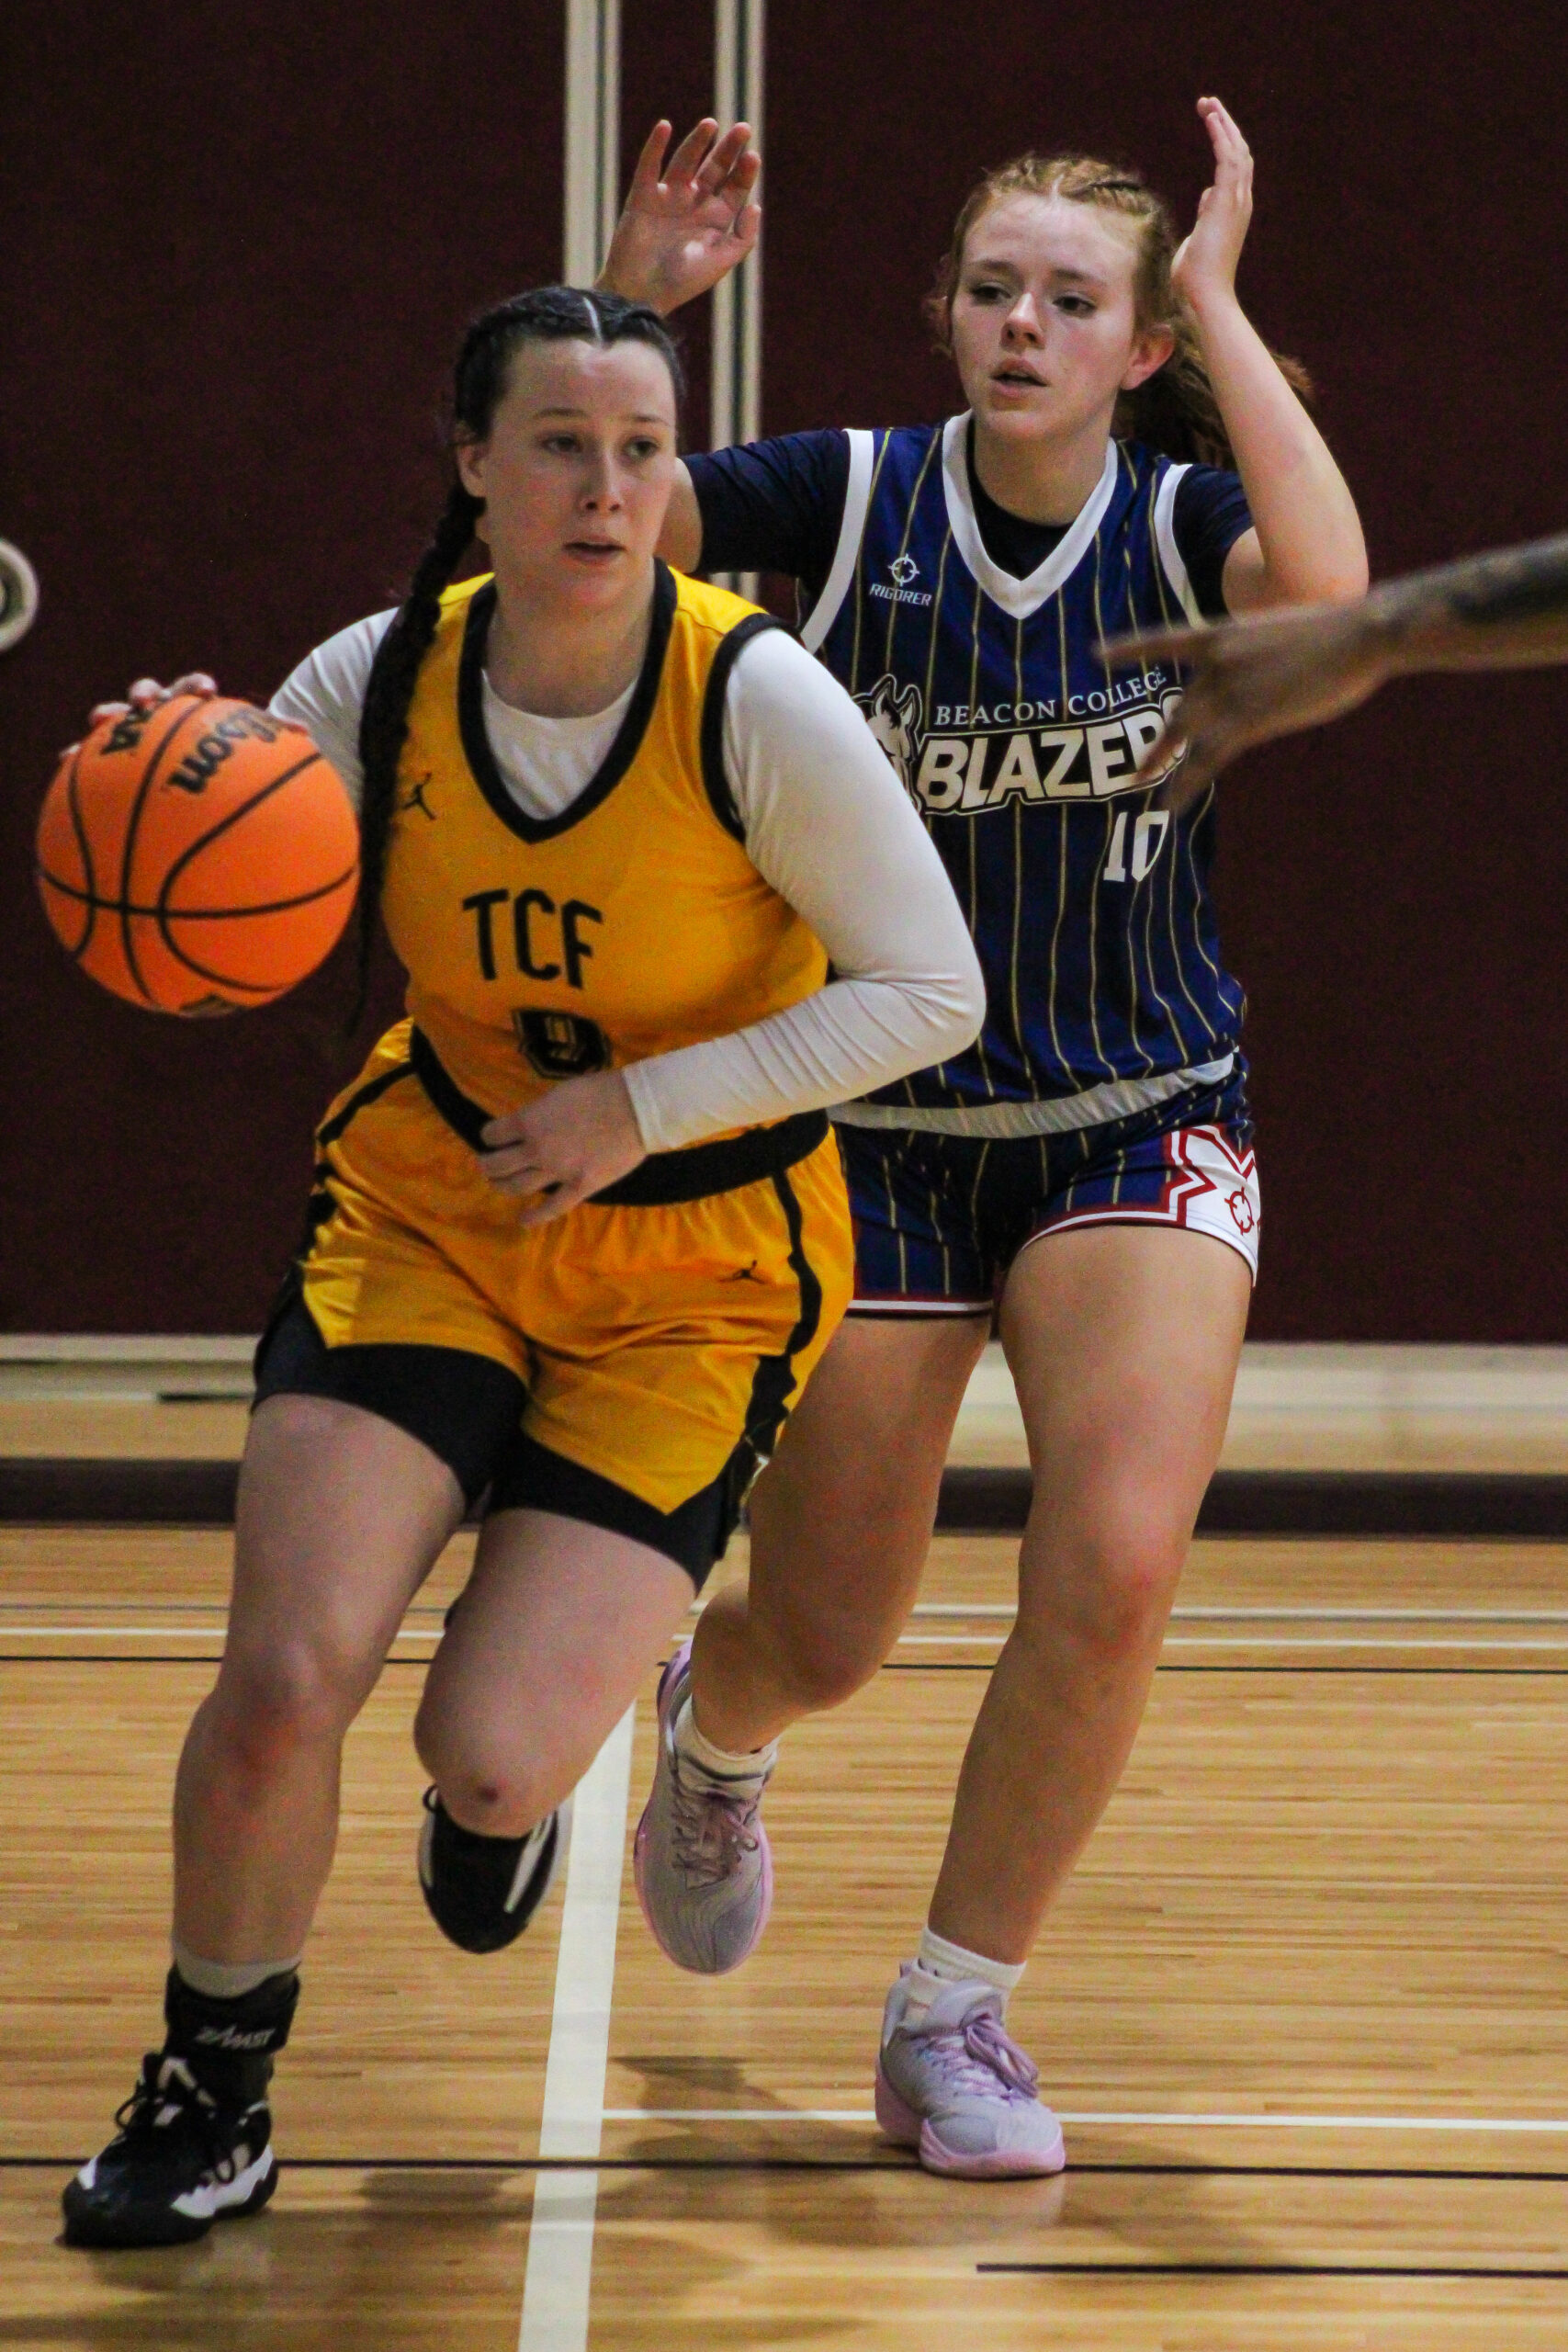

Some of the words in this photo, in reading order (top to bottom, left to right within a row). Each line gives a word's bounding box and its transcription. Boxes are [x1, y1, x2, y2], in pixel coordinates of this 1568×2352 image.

[869, 582, 932, 606] RIGORER
[166, 708, 276, 794] lson
[917, 695, 1185, 809] BLAZER
[933, 699, 1055, 726] BEACON
[1103, 810, 1169, 882] 10
[463, 888, 604, 990] TCF
